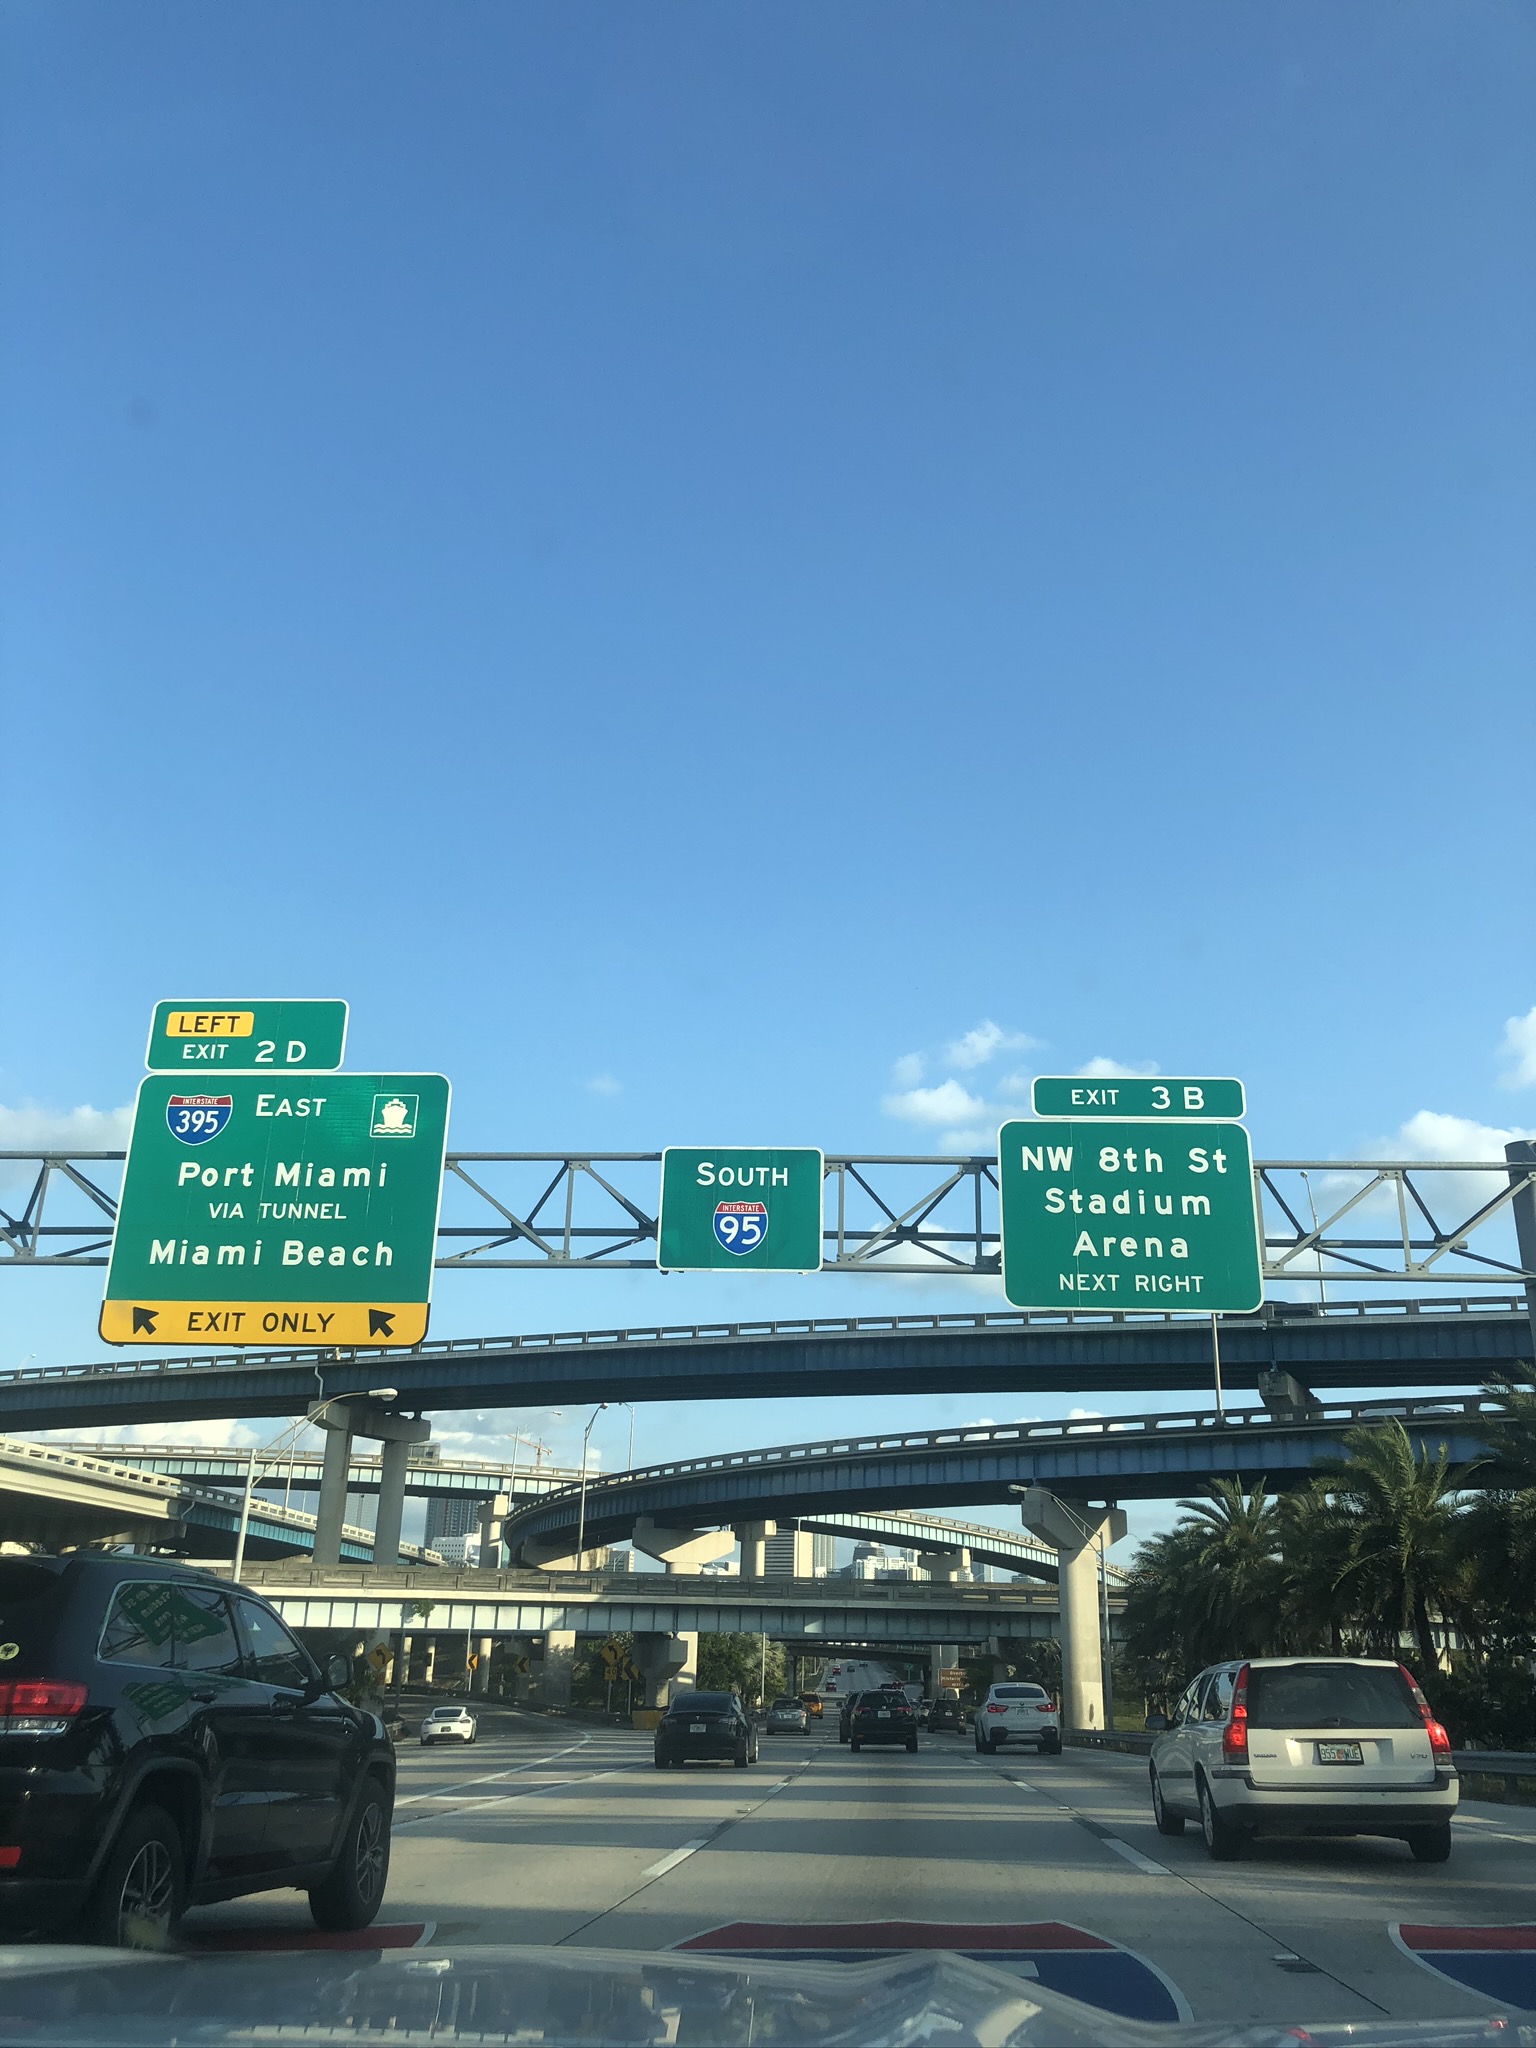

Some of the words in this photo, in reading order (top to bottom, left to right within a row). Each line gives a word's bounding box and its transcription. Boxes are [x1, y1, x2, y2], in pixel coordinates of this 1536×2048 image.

[179, 1016, 240, 1033] LEFT
[182, 1044, 229, 1059] EXIT
[255, 1094, 327, 1117] EAST
[1071, 1089, 1119, 1105] EXIT
[175, 1110, 219, 1134] 395
[1021, 1146, 1073, 1172] NW
[1099, 1146, 1163, 1173] 8th
[1188, 1147, 1227, 1174] St
[178, 1162, 254, 1188] Port
[275, 1162, 388, 1188] Miami
[696, 1162, 788, 1187] SOUTH
[208, 1202, 245, 1219] VIA
[260, 1203, 347, 1220] TUNNEL
[722, 1204, 760, 1212] INTERSTATE
[1044, 1188, 1211, 1216] Stadium
[719, 1216, 761, 1245] 95
[150, 1239, 262, 1266] Miami
[282, 1240, 393, 1267] Beach
[1072, 1230, 1189, 1258] Arena
[1059, 1273, 1120, 1292] NEXT
[1135, 1275, 1204, 1293] RIGHT
[187, 1312, 246, 1332] EXIT
[262, 1312, 335, 1333] ONLY
